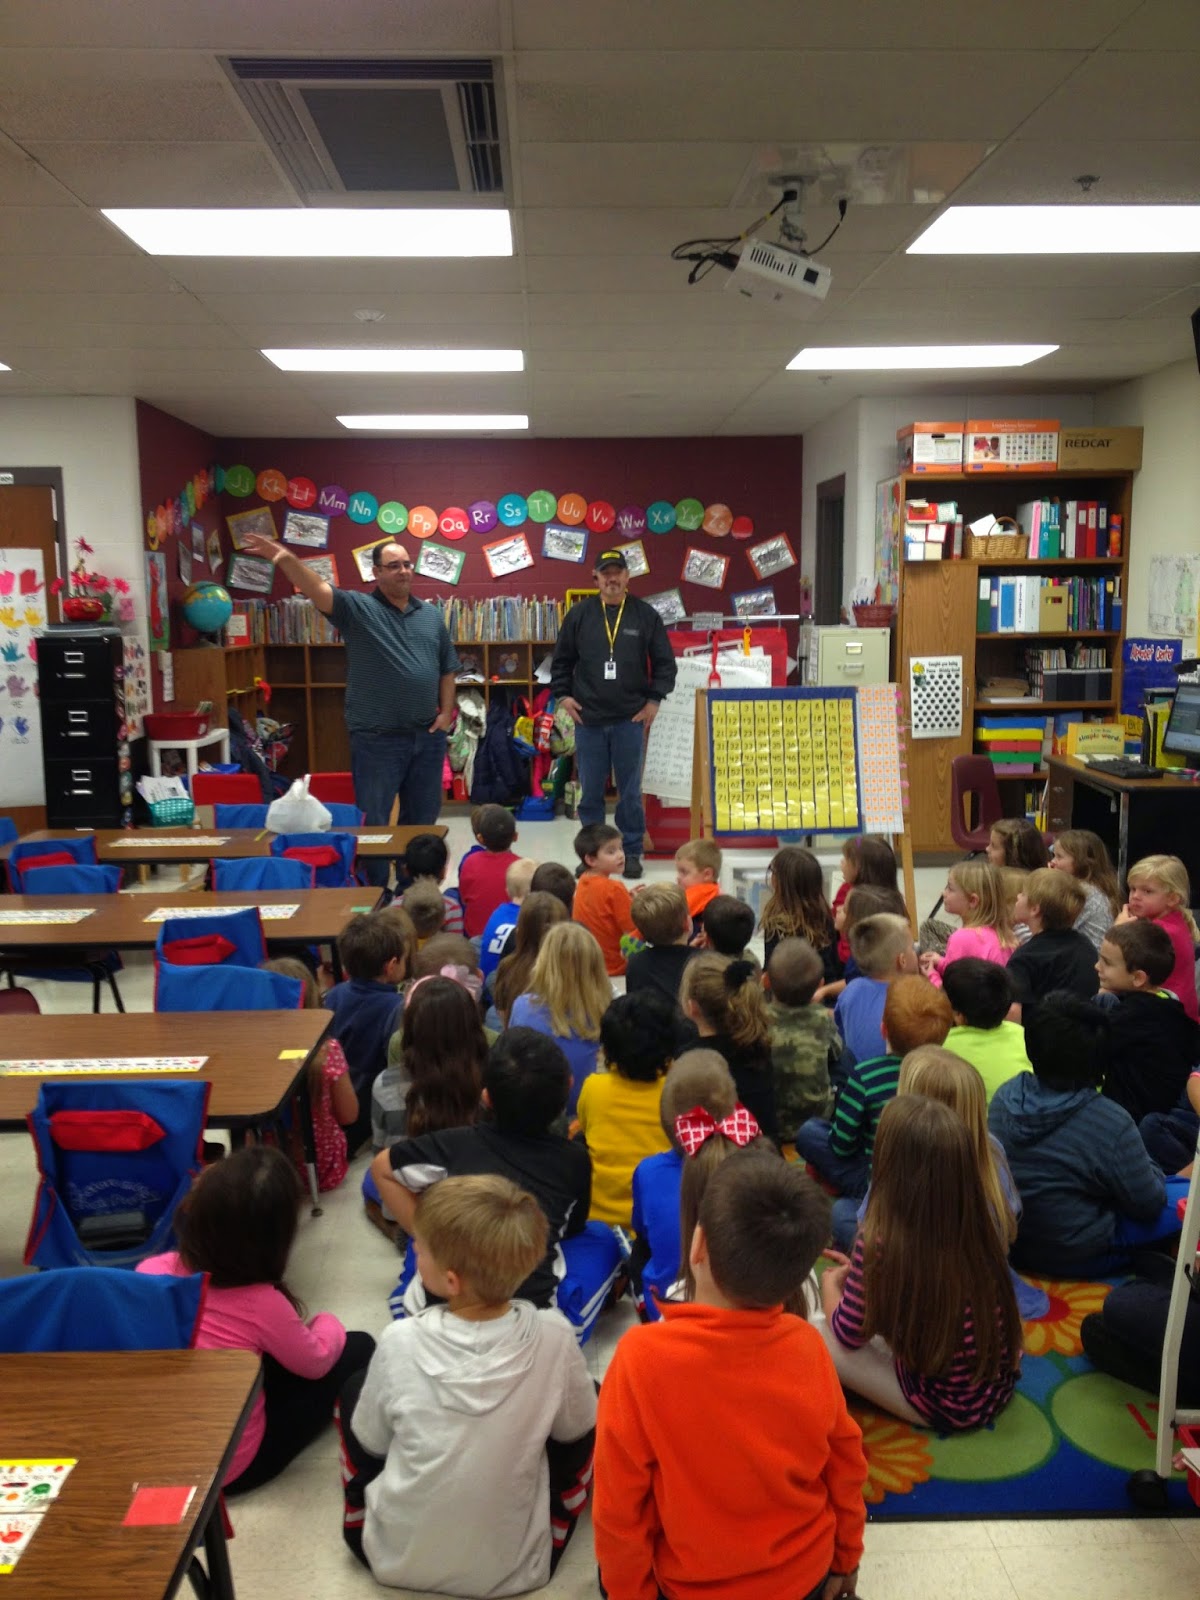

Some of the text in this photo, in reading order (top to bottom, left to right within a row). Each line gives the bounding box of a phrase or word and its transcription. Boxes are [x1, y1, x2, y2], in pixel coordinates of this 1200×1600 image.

[1065, 438, 1112, 448] REDCAT
[319, 490, 347, 511] Mm
[352, 499, 372, 517] Nn
[381, 509, 405, 526] Oo
[412, 513, 432, 534] Pp
[472, 510, 491, 526] Rr
[504, 502, 522, 518] Ss
[533, 499, 550, 514] Tt
[562, 501, 581, 518] Uu
[592, 508, 609, 525] Vv
[619, 514, 645, 530] Ww
[652, 510, 671, 526] Xx
[681, 506, 699, 526] Yy
